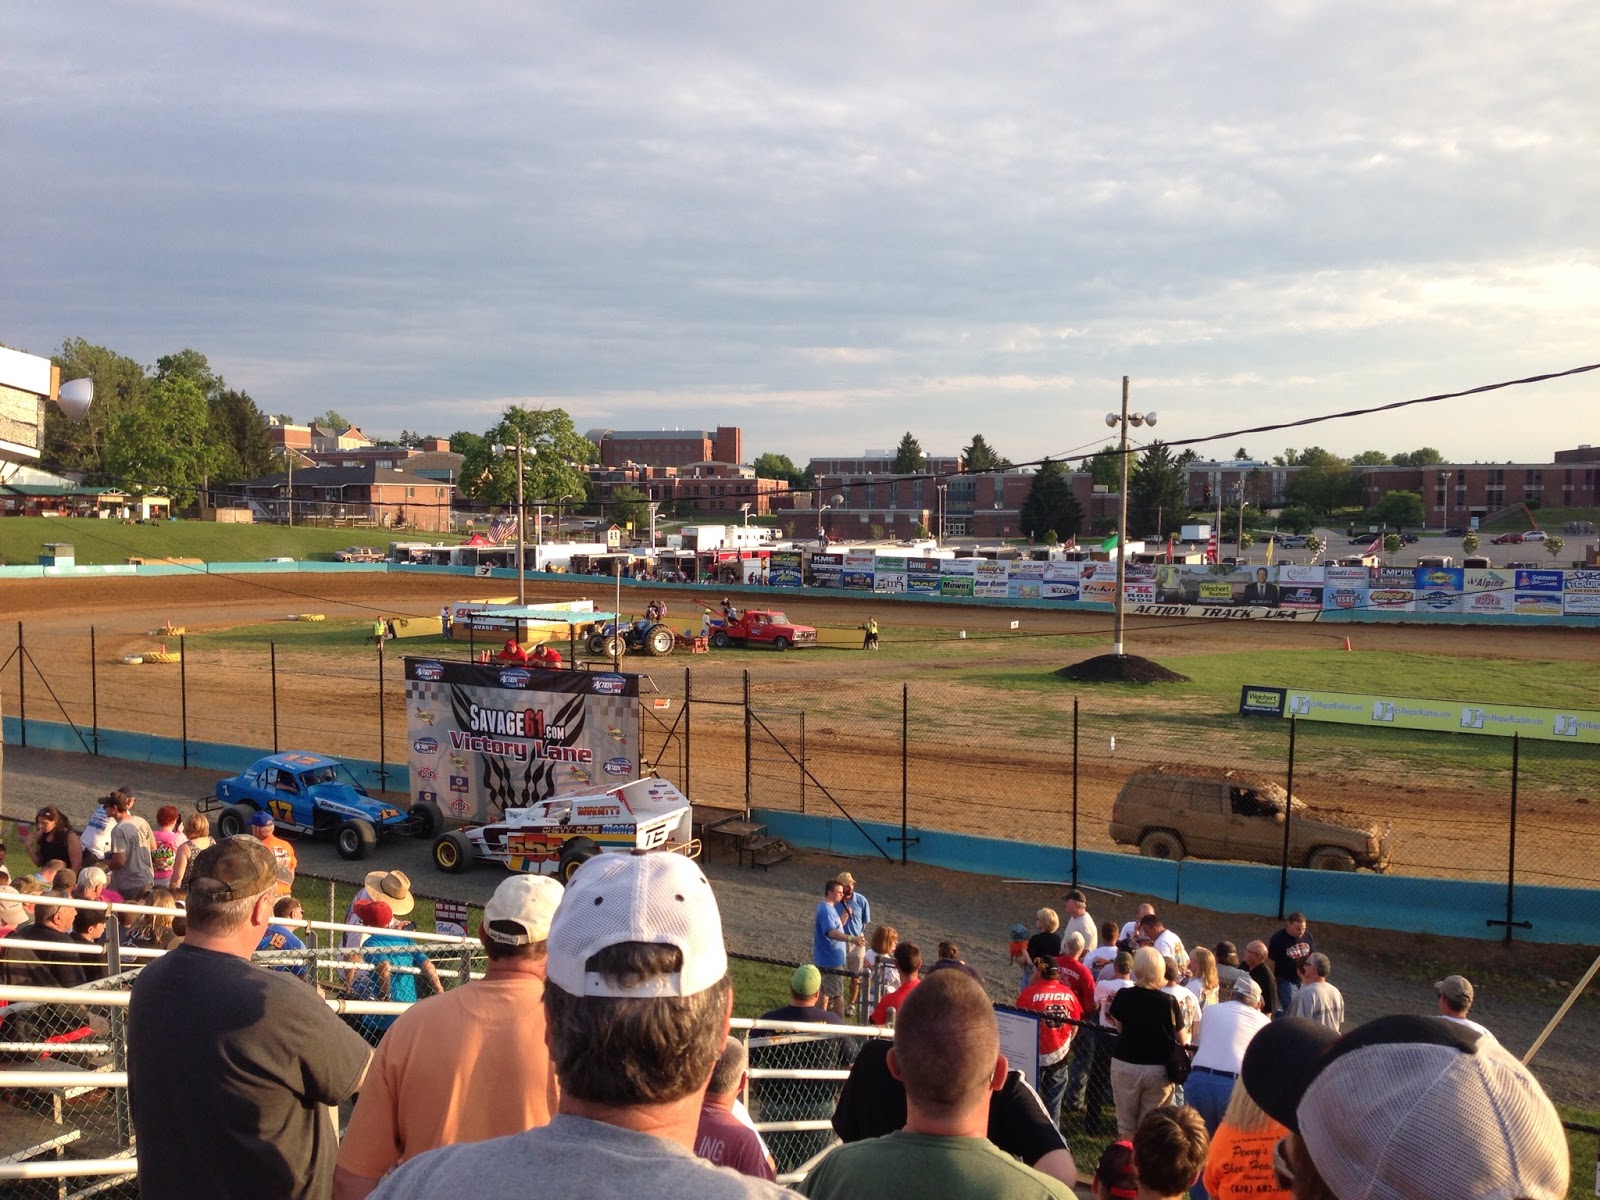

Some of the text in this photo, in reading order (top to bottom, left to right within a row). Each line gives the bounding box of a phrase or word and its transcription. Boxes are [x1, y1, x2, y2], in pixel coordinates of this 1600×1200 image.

[1380, 567, 1415, 577] EMPIRE
[943, 581, 970, 590] Mower
[1201, 584, 1230, 592] Weichert
[1475, 578, 1505, 588] Alpine
[1133, 605, 1298, 619] ACTION TRACK USA
[593, 680, 613, 690] ACTION
[1249, 692, 1278, 701] Weichert
[470, 703, 565, 740] SAVAGE61.COM
[448, 730, 593, 765] Victory Lane
[268, 800, 297, 826] 17
[541, 825, 600, 835] CHEVY-OLDS
[699, 1135, 726, 1162] ING
[1232, 1144, 1269, 1159] Penny's
[1231, 1184, 1253, 1195] (610)
